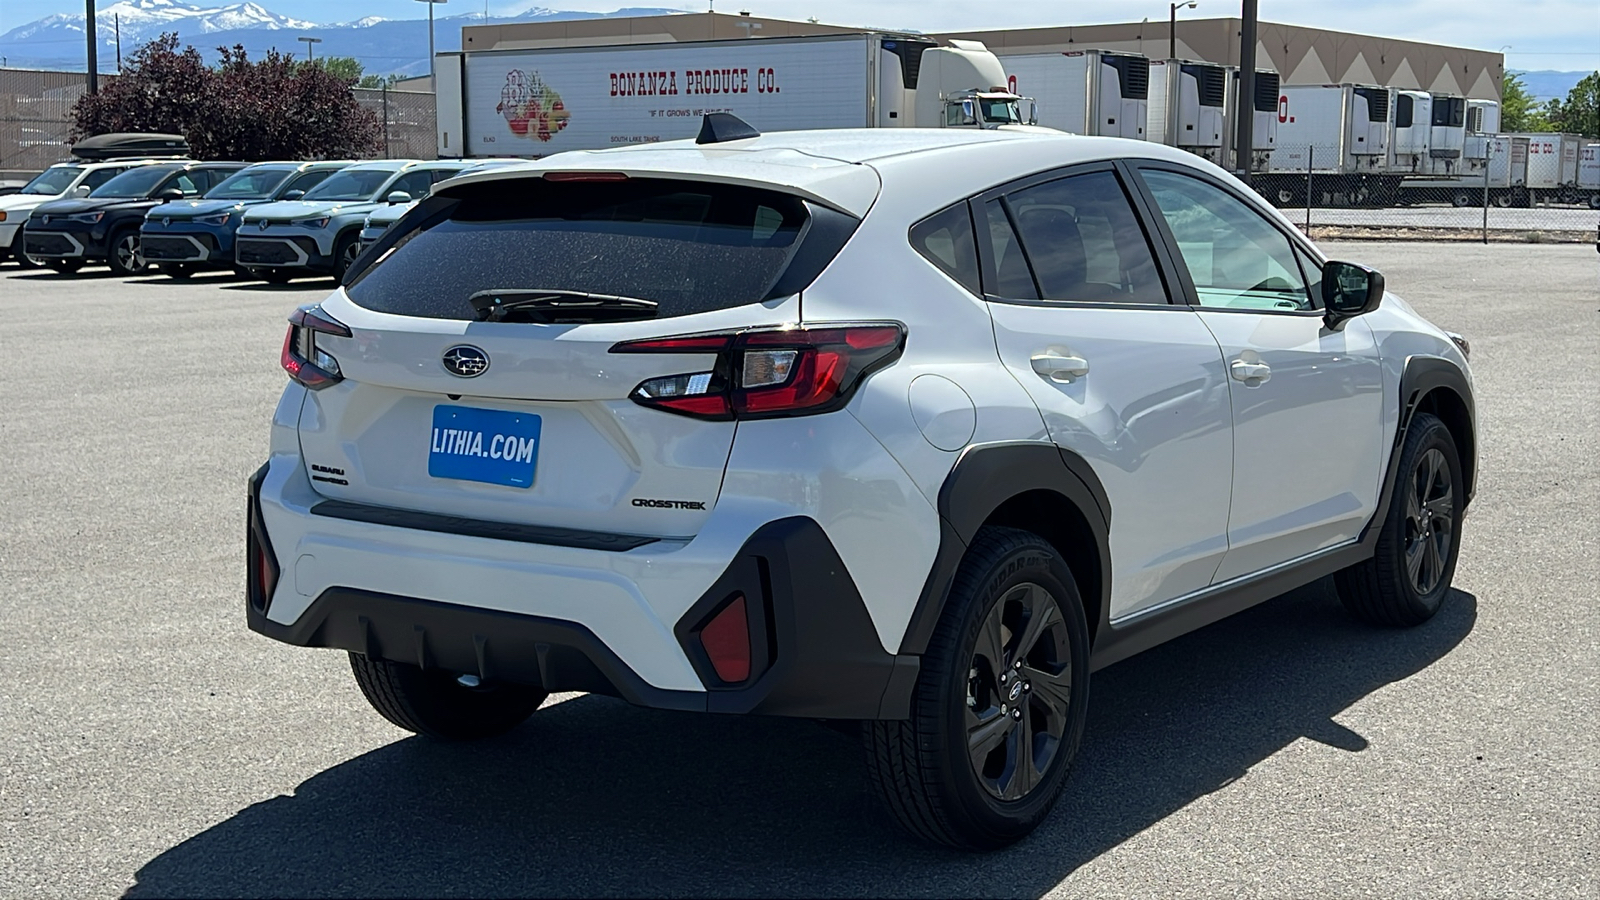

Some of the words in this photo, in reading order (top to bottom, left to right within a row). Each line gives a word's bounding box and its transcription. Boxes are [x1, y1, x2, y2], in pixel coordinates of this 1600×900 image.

[610, 71, 678, 96] BONANZA
[686, 69, 748, 94] PRODUCE
[757, 68, 780, 93] CO.
[693, 109, 703, 117] WE
[432, 428, 535, 464] LITHIA.COM
[311, 464, 345, 476] SUBARU
[631, 498, 706, 511] CROSSTREK
